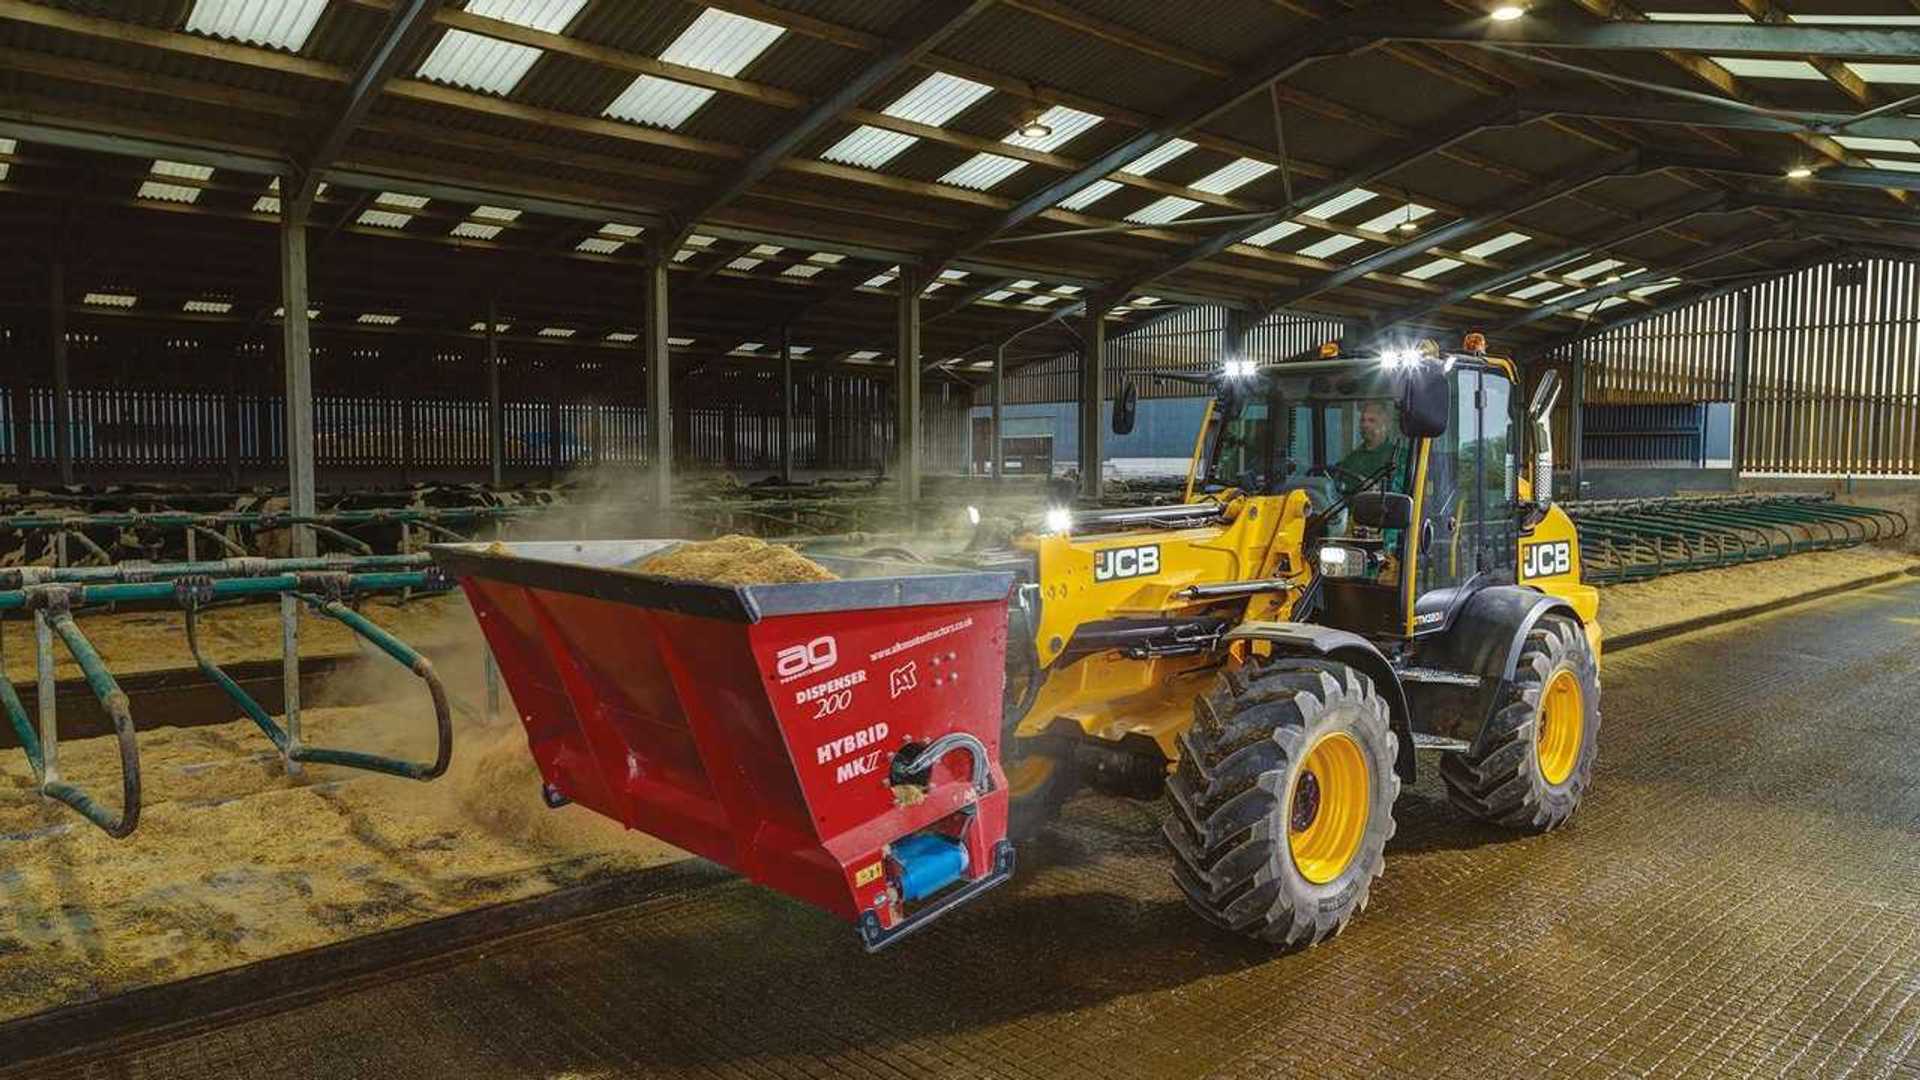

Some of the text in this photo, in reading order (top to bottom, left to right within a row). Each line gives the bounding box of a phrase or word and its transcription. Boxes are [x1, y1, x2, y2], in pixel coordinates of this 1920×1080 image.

[1096, 546, 1159, 580] JCB
[1524, 543, 1569, 577] JCB
[796, 670, 866, 704] DISPENSER
[890, 661, 917, 699] AT
[813, 690, 852, 719] 200
[816, 722, 889, 765] HYBRID
